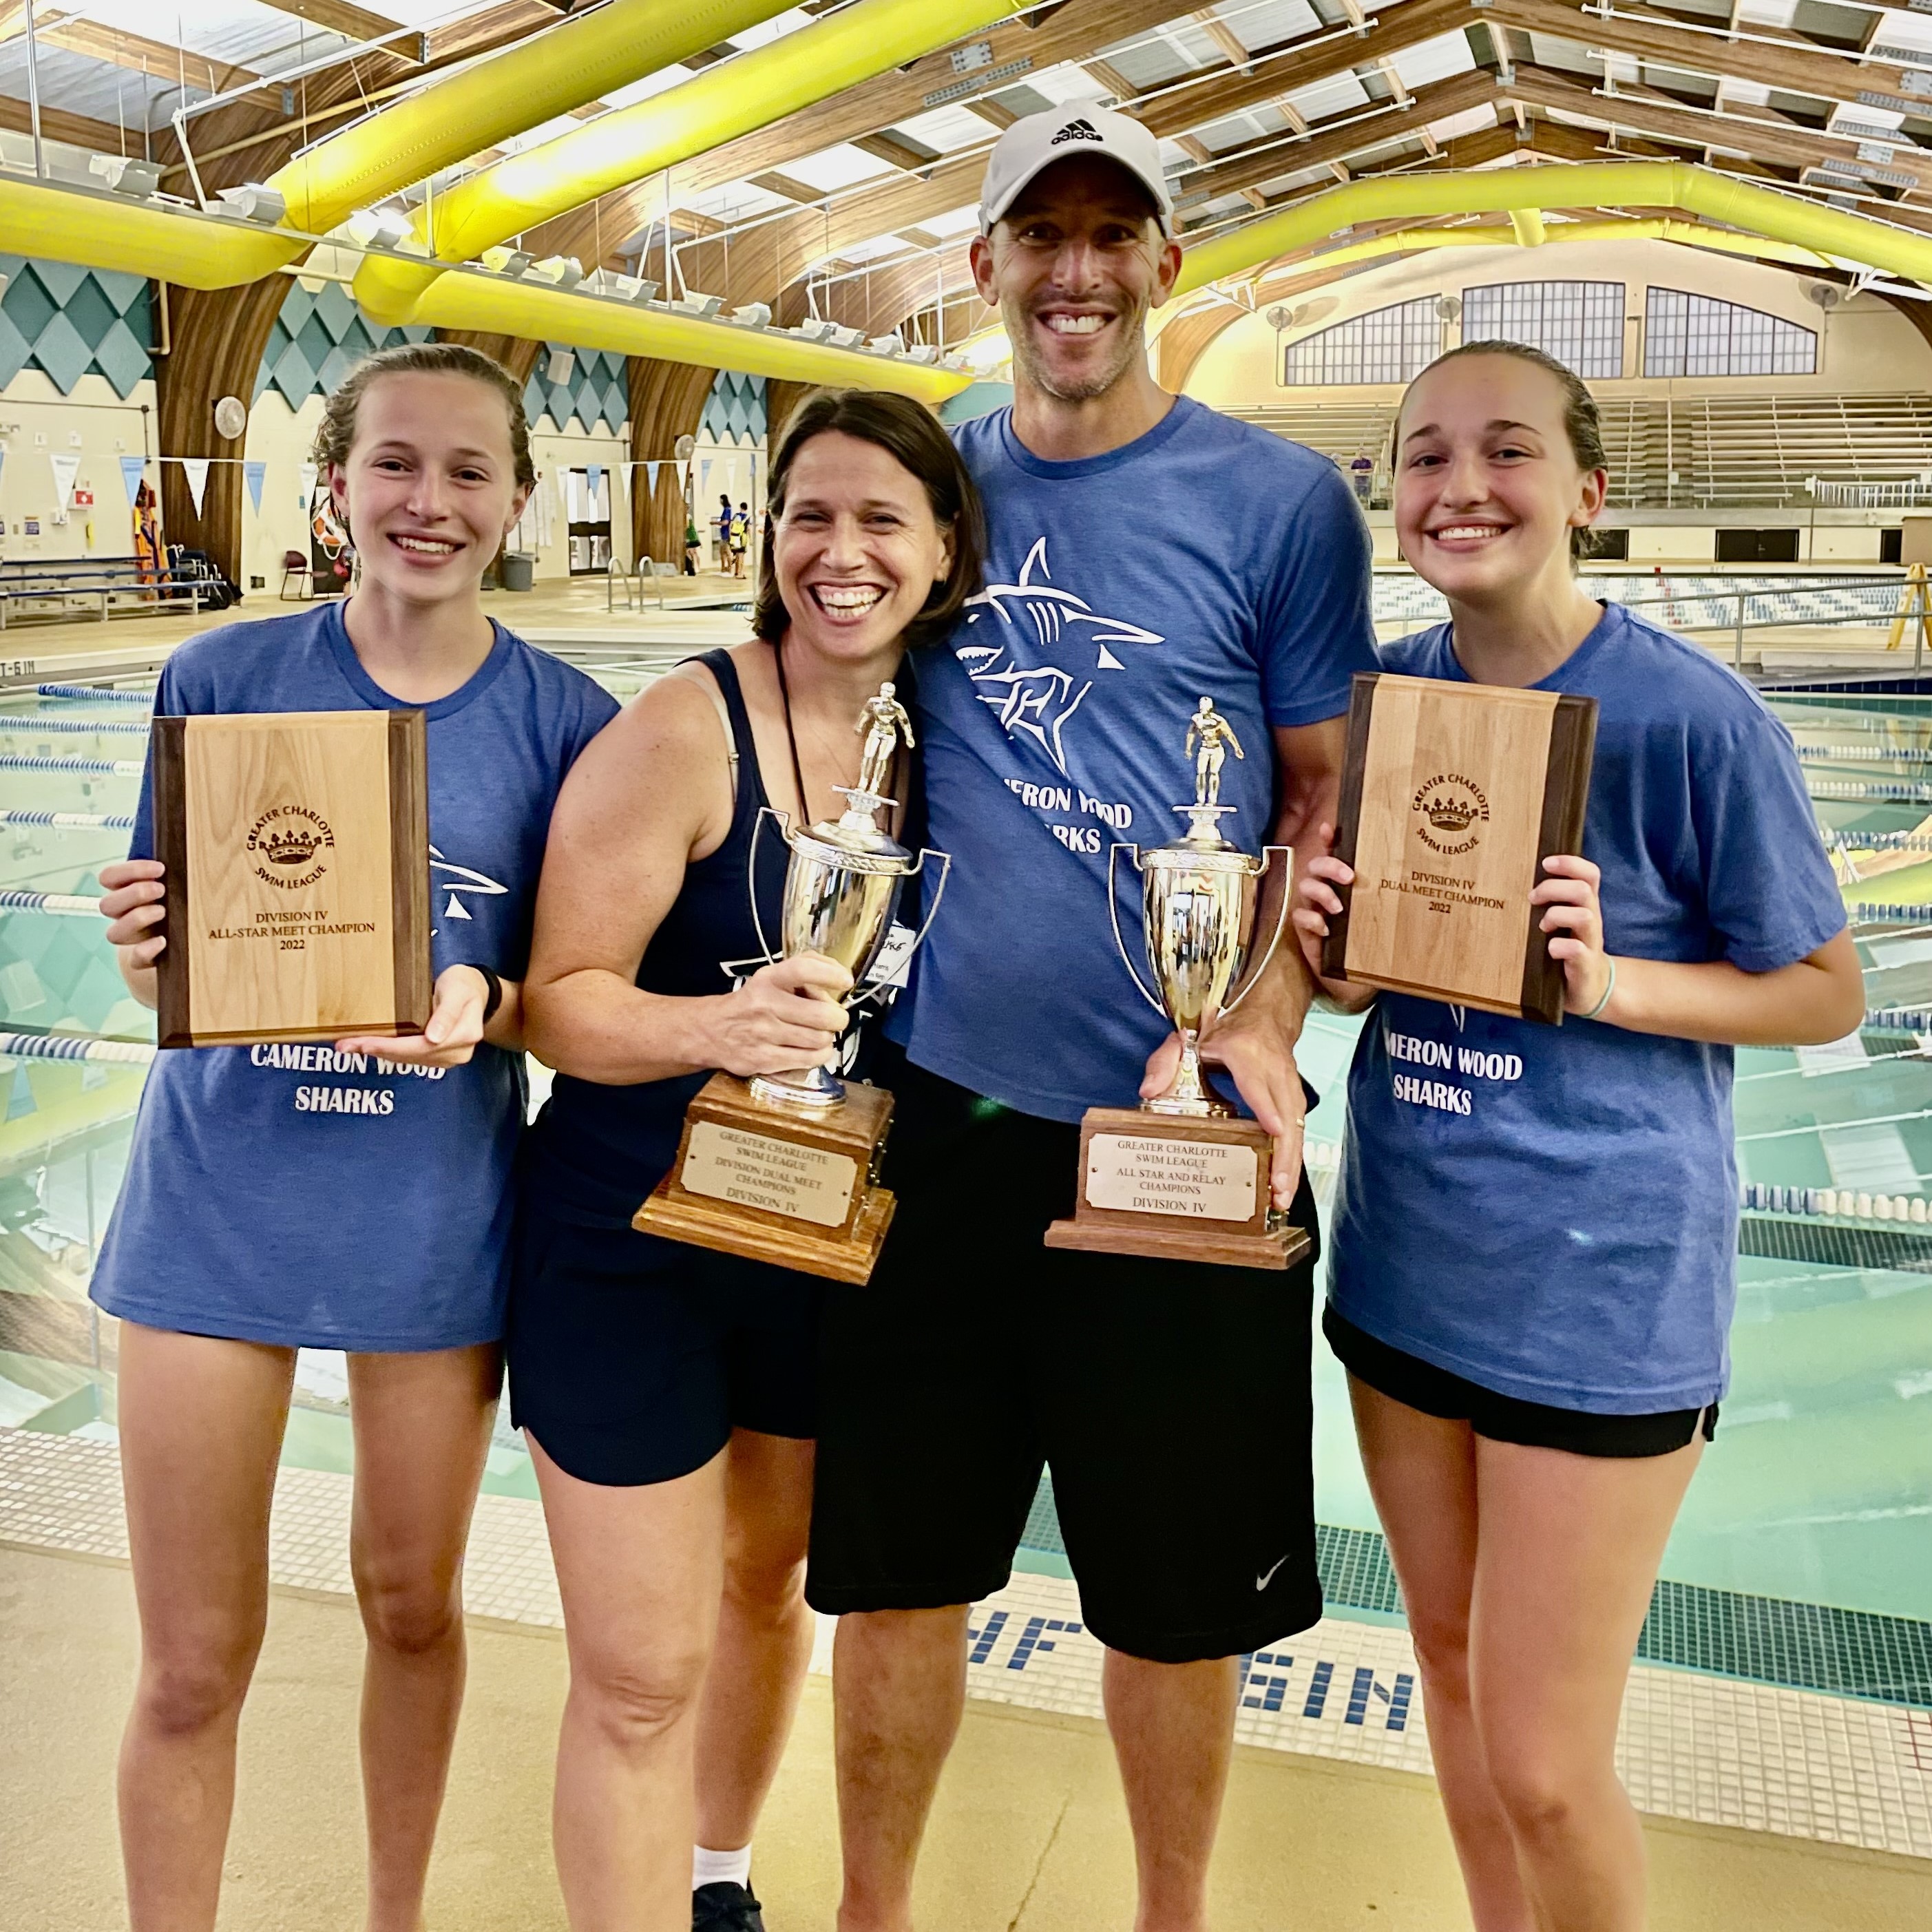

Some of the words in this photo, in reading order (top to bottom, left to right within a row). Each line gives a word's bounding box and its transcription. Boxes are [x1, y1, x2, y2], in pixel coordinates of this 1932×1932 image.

[1051, 129, 1103, 145] adidas
[1412, 775, 1445, 811] GREATER
[1448, 774, 1489, 821] CHARLOTTE
[246, 809, 280, 851] GREATER
[283, 806, 335, 848] CHARLOTTE
[1044, 823, 1101, 854] RKS
[1417, 828, 1440, 852] SWIM
[1443, 837, 1480, 854] LEAGUE
[255, 867, 284, 888] SWIM
[287, 865, 326, 889] LEAGUE
[1411, 871, 1460, 888] DIVISION
[1463, 880, 1476, 890] IV
[1381, 879, 1410, 893] DUAL
[1413, 885, 1442, 899] MEET
[1445, 891, 1504, 910] CHAMPION
[255, 912, 311, 923] DIVISION
[315, 910, 328, 921] IV
[1429, 901, 1451, 914] 2022
[209, 927, 269, 939] ALL-STAR
[272, 925, 305, 936] MEET
[308, 923, 375, 935] CHAMPION
[280, 939, 305, 950] 2022
[250, 1043, 368, 1074] CAMERON
[1458, 1047, 1523, 1080] WOOD
[295, 1086, 395, 1115] SHARKS
[1394, 1074, 1472, 1116] SHARKS
[720, 1131, 766, 1150] GREATER
[768, 1142, 829, 1165] CHARLOTTE
[736, 1146, 765, 1162] SWIM
[766, 1153, 807, 1171] LEAGUE
[1117, 1140, 1164, 1153] GREATER
[1166, 1145, 1228, 1158] CHARLOTTE
[1136, 1154, 1164, 1165] SWIM
[1167, 1157, 1208, 1168] LEAGUE
[715, 1157, 760, 1175] DIVISION
[763, 1168, 791, 1183] DUAL
[794, 1175, 823, 1190] MEET
[735, 1173, 796, 1195] CHAMPIONS
[1116, 1168, 1136, 1177] ALL
[1140, 1170, 1164, 1180] STAR
[1168, 1172, 1190, 1182] AND
[1192, 1175, 1226, 1186] RELAY
[726, 1187, 780, 1208] DIVISION
[786, 1201, 800, 1212] IV
[1140, 1181, 1201, 1195] CHAMPIONS
[1133, 1197, 1187, 1211] DIVISION
[1193, 1202, 1206, 1212] IV
